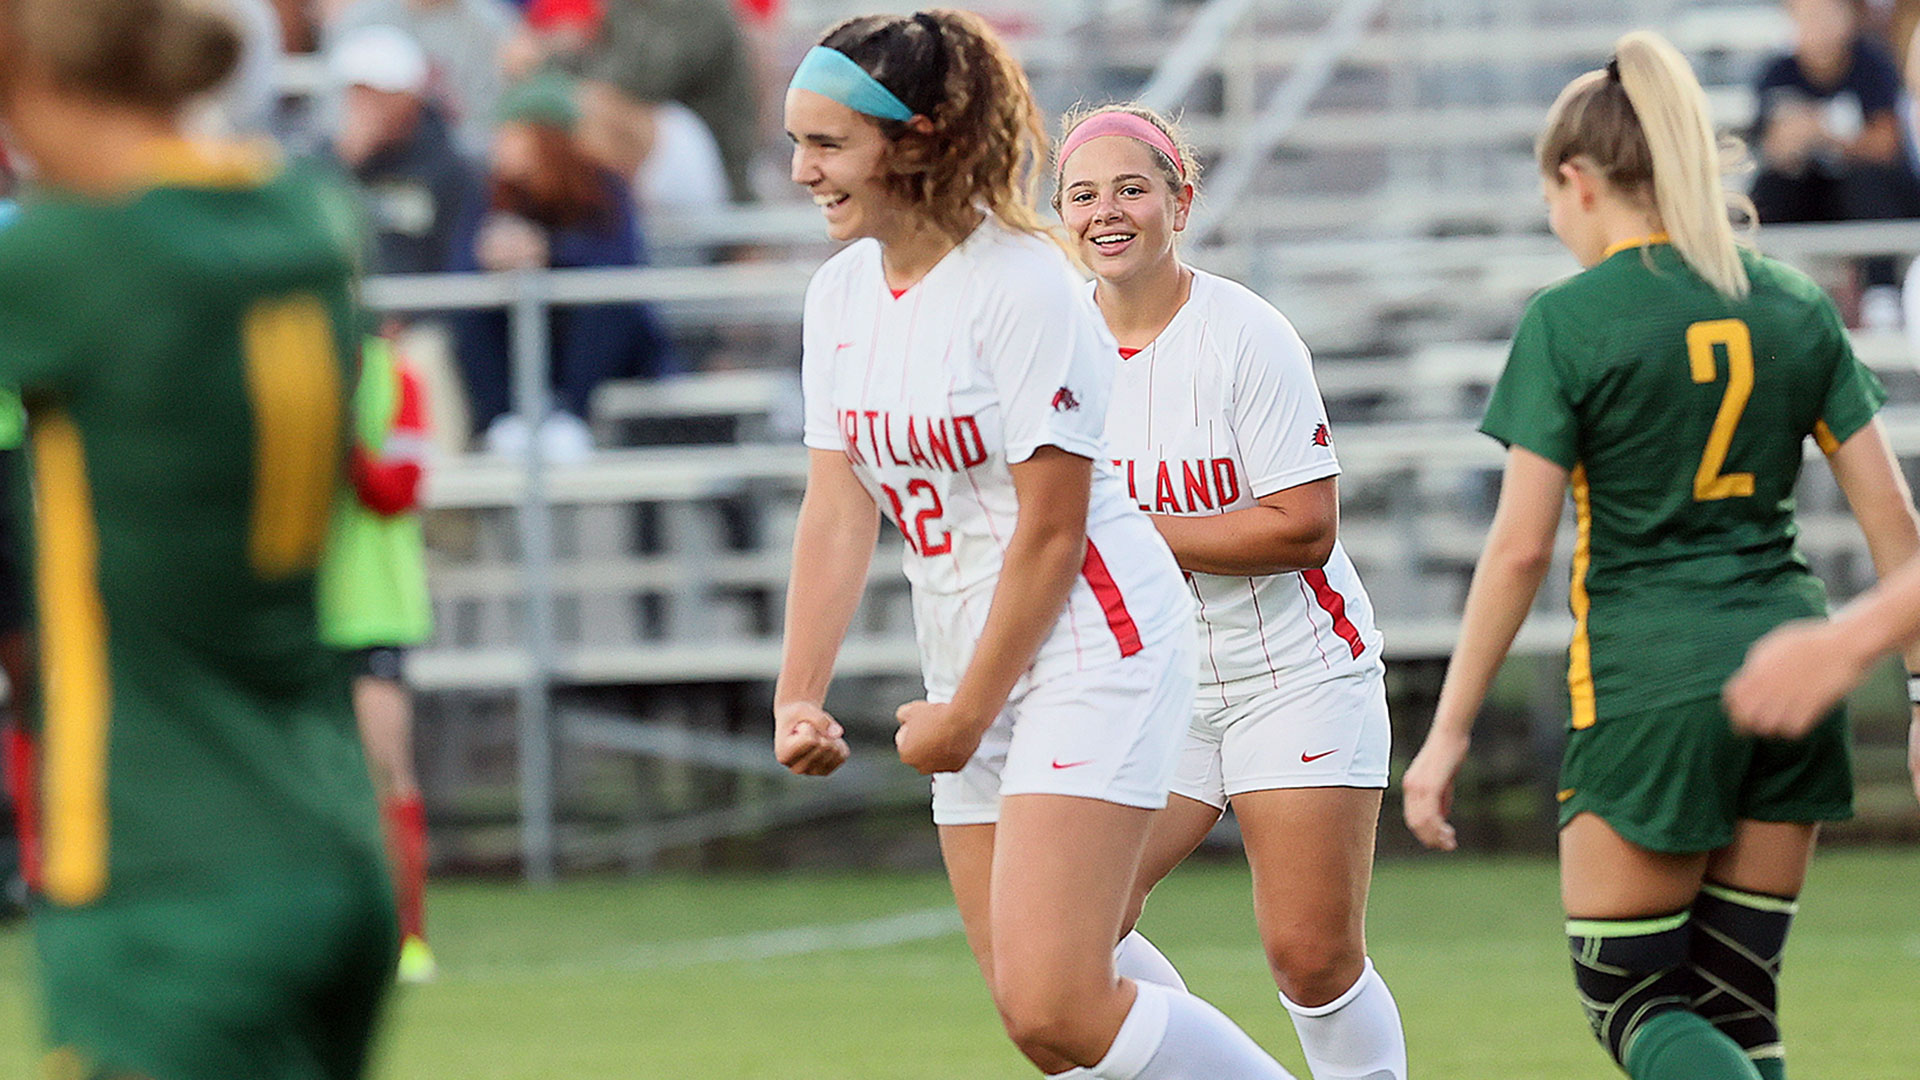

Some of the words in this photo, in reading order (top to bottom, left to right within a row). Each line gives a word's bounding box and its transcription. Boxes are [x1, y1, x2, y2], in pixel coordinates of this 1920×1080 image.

[837, 409, 988, 473] RTLAND
[1686, 318, 1755, 501] 2
[1111, 457, 1240, 513] LAND
